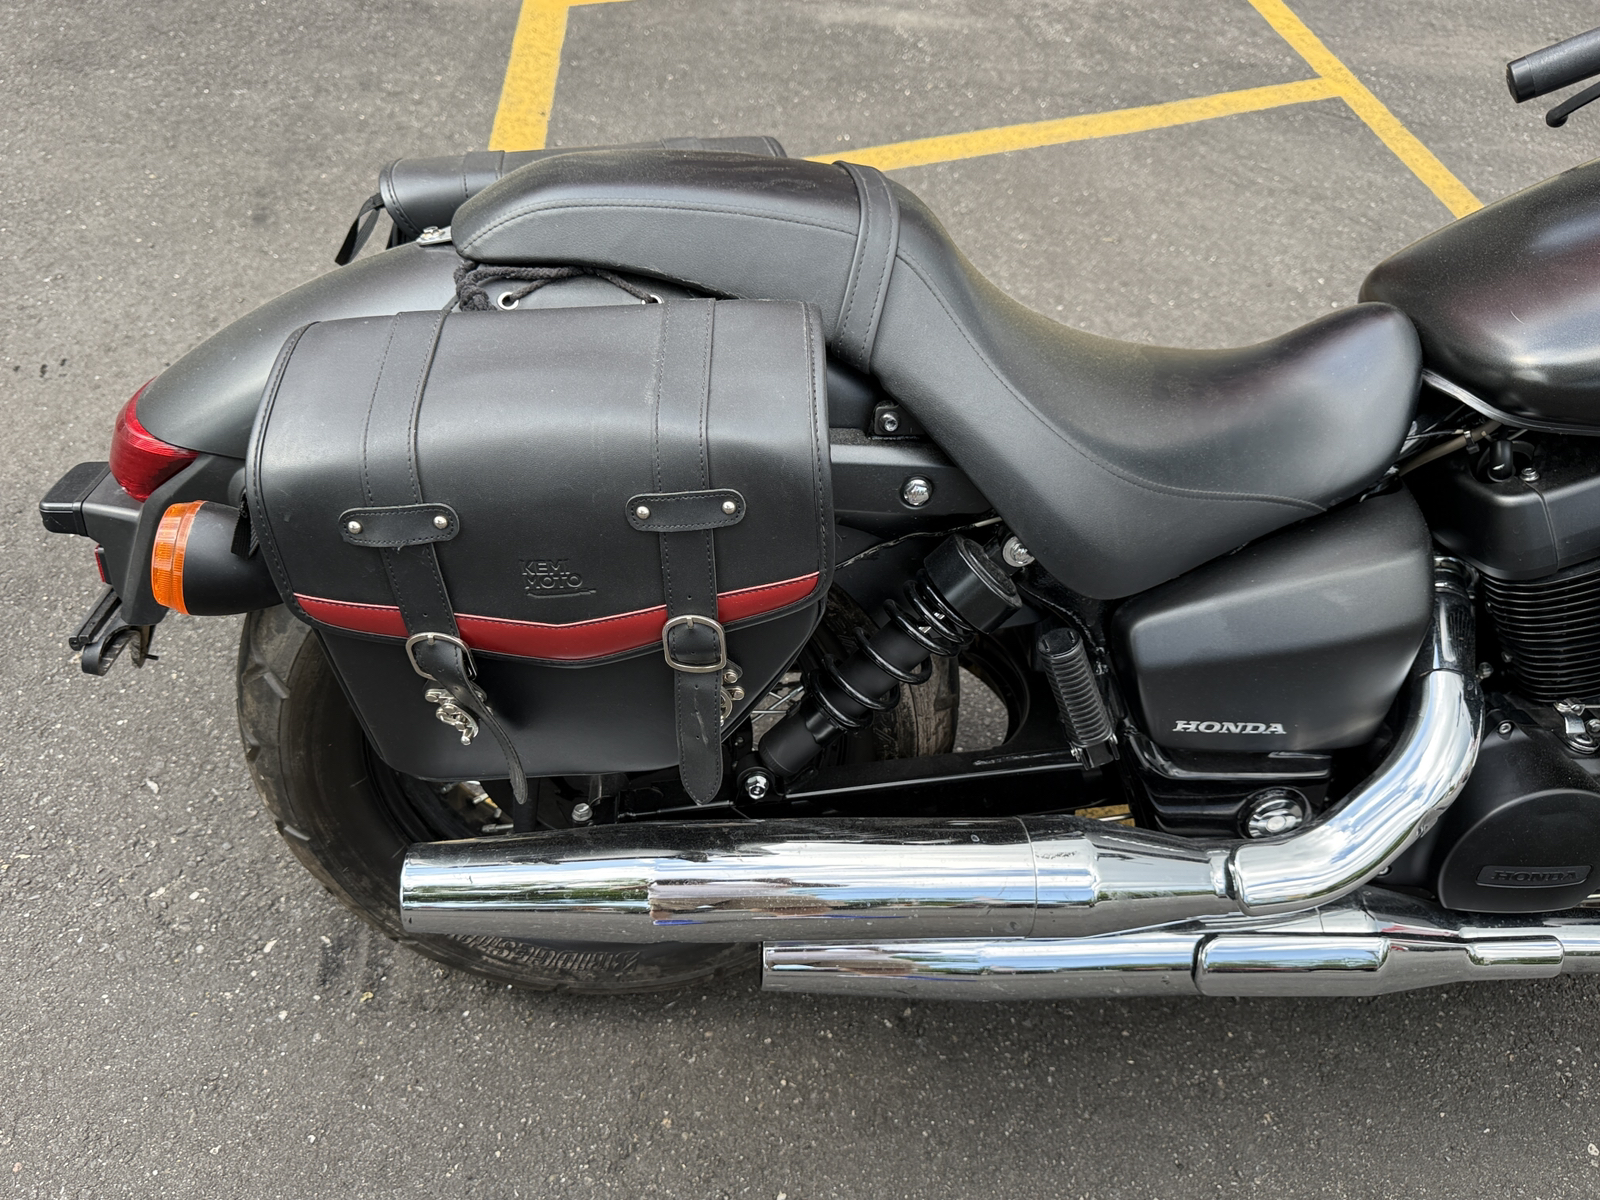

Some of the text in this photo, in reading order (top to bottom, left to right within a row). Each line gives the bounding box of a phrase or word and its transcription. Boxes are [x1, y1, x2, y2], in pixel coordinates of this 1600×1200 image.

[519, 559, 570, 575] KEMI
[521, 574, 583, 590] MOTO
[1172, 720, 1287, 734] HONDA
[1491, 870, 1580, 881] HONDA
[449, 933, 642, 973] BRIDGESTO
